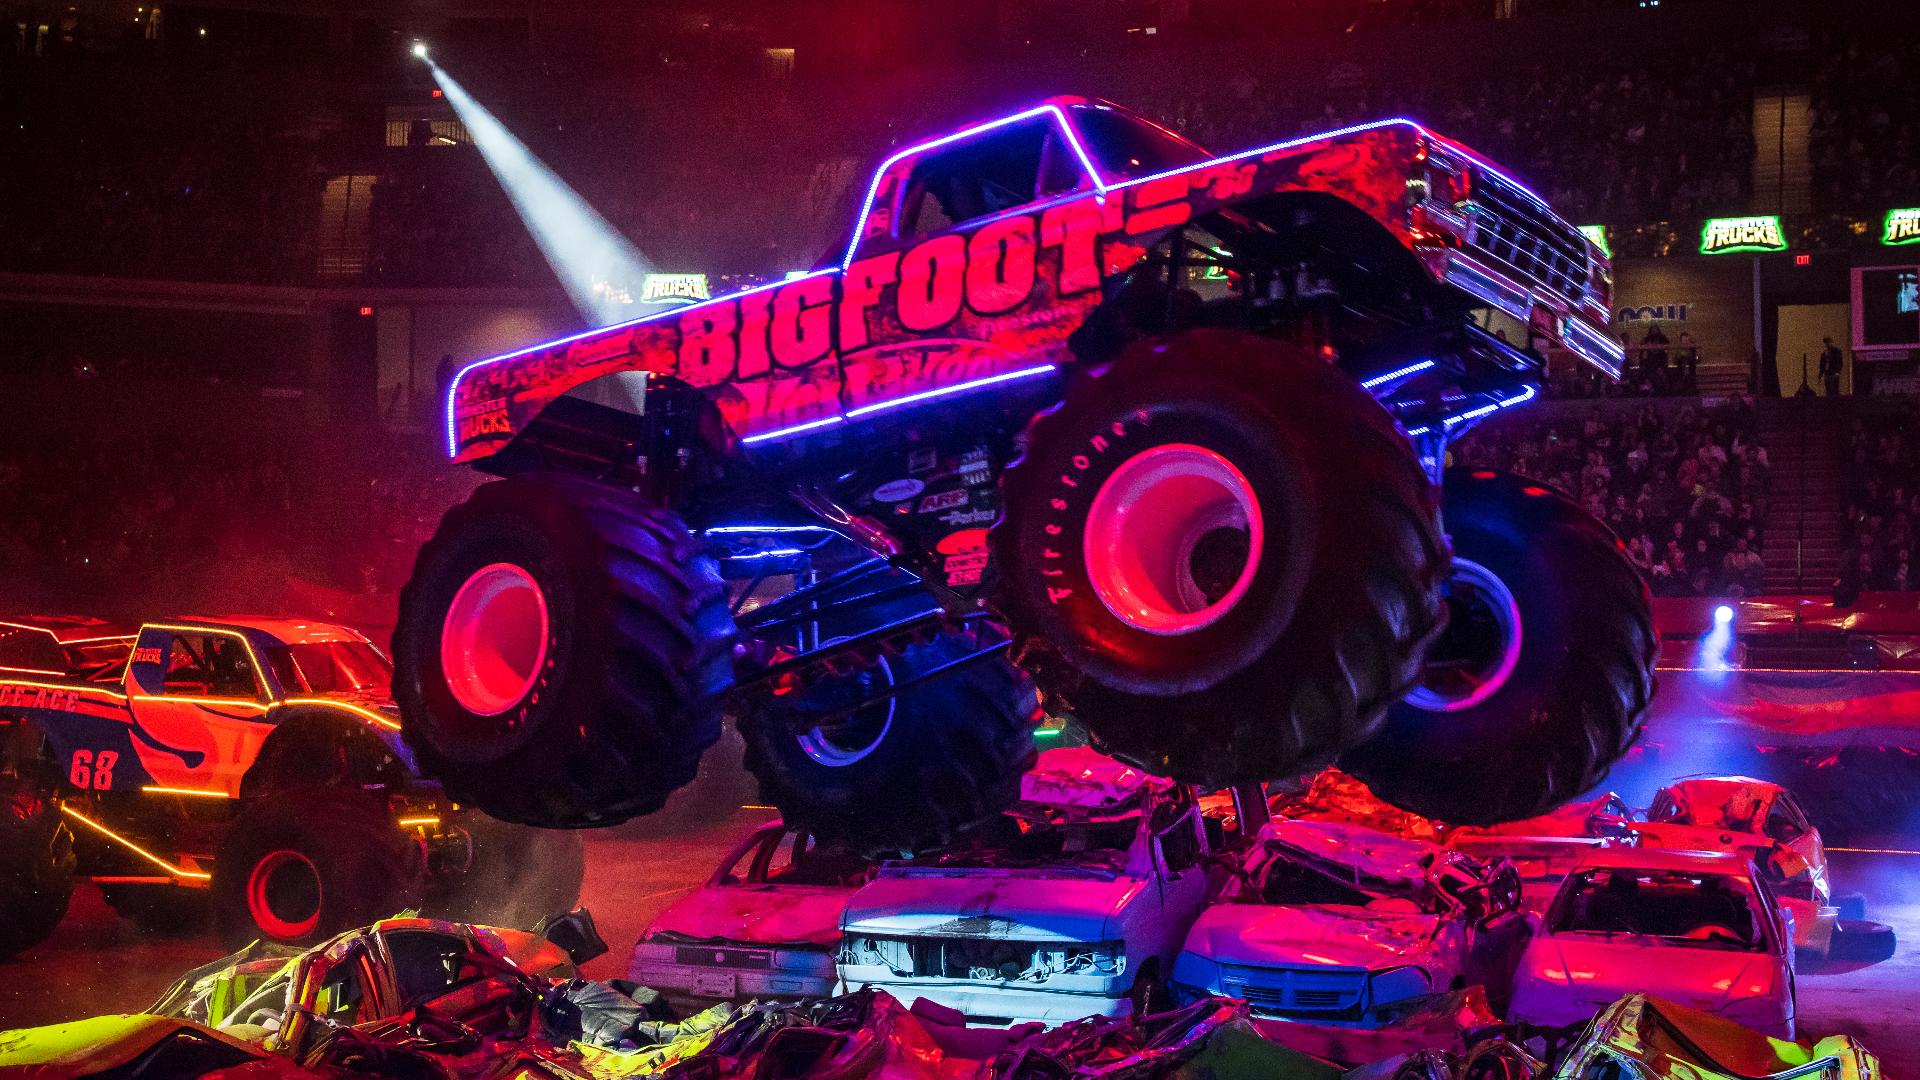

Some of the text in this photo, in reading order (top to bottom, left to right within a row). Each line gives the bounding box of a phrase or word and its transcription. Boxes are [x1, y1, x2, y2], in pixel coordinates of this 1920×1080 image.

[1705, 225, 1782, 249] TRUCKS
[1795, 254, 1810, 265] EXIT
[646, 282, 705, 299] TRUCKS
[679, 190, 1123, 388] BIGFOOT
[1042, 421, 1127, 605] Firestone
[132, 652, 161, 664] TRUCKS
[32, 687, 80, 713] ACE
[70, 749, 119, 791] 68
